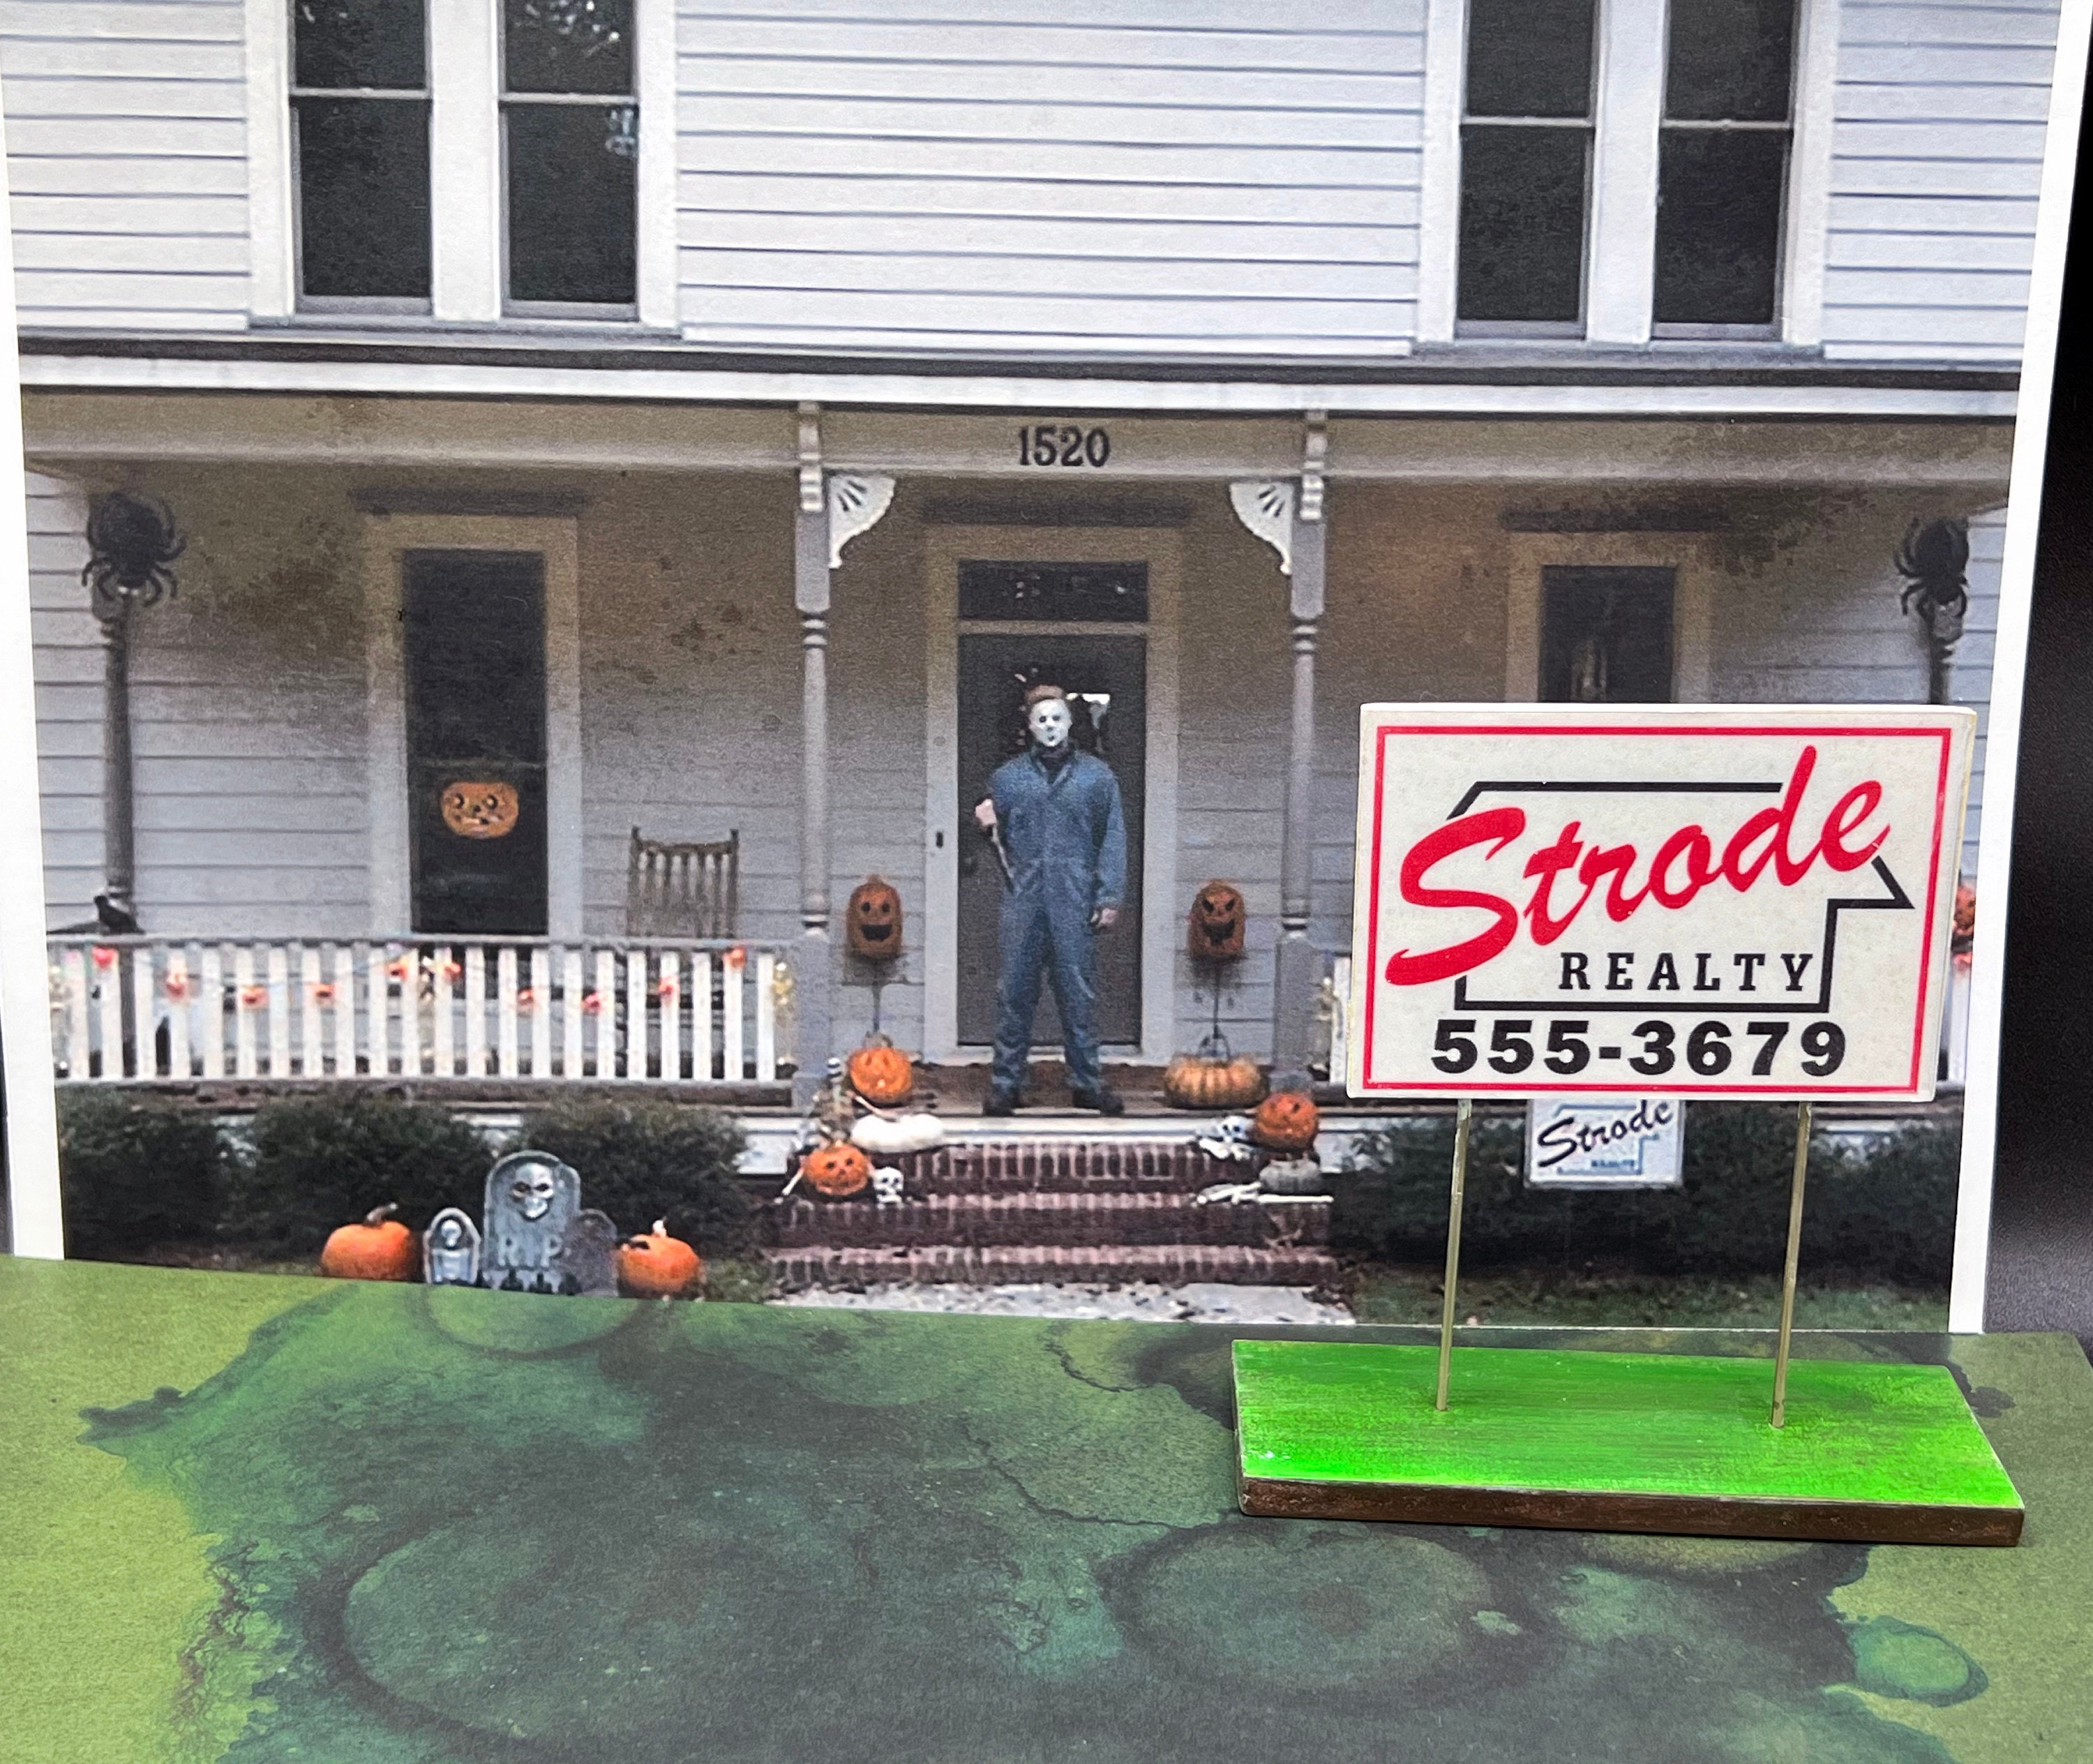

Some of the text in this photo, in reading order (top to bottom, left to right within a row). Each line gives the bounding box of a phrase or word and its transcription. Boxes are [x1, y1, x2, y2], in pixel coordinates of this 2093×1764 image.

[1019, 425, 1111, 468] 1520
[1385, 745, 1891, 985] Strode
[1558, 952, 1813, 992] REALTY
[1431, 1019, 1846, 1077] 555-3679
[1538, 1100, 1672, 1167] Strode
